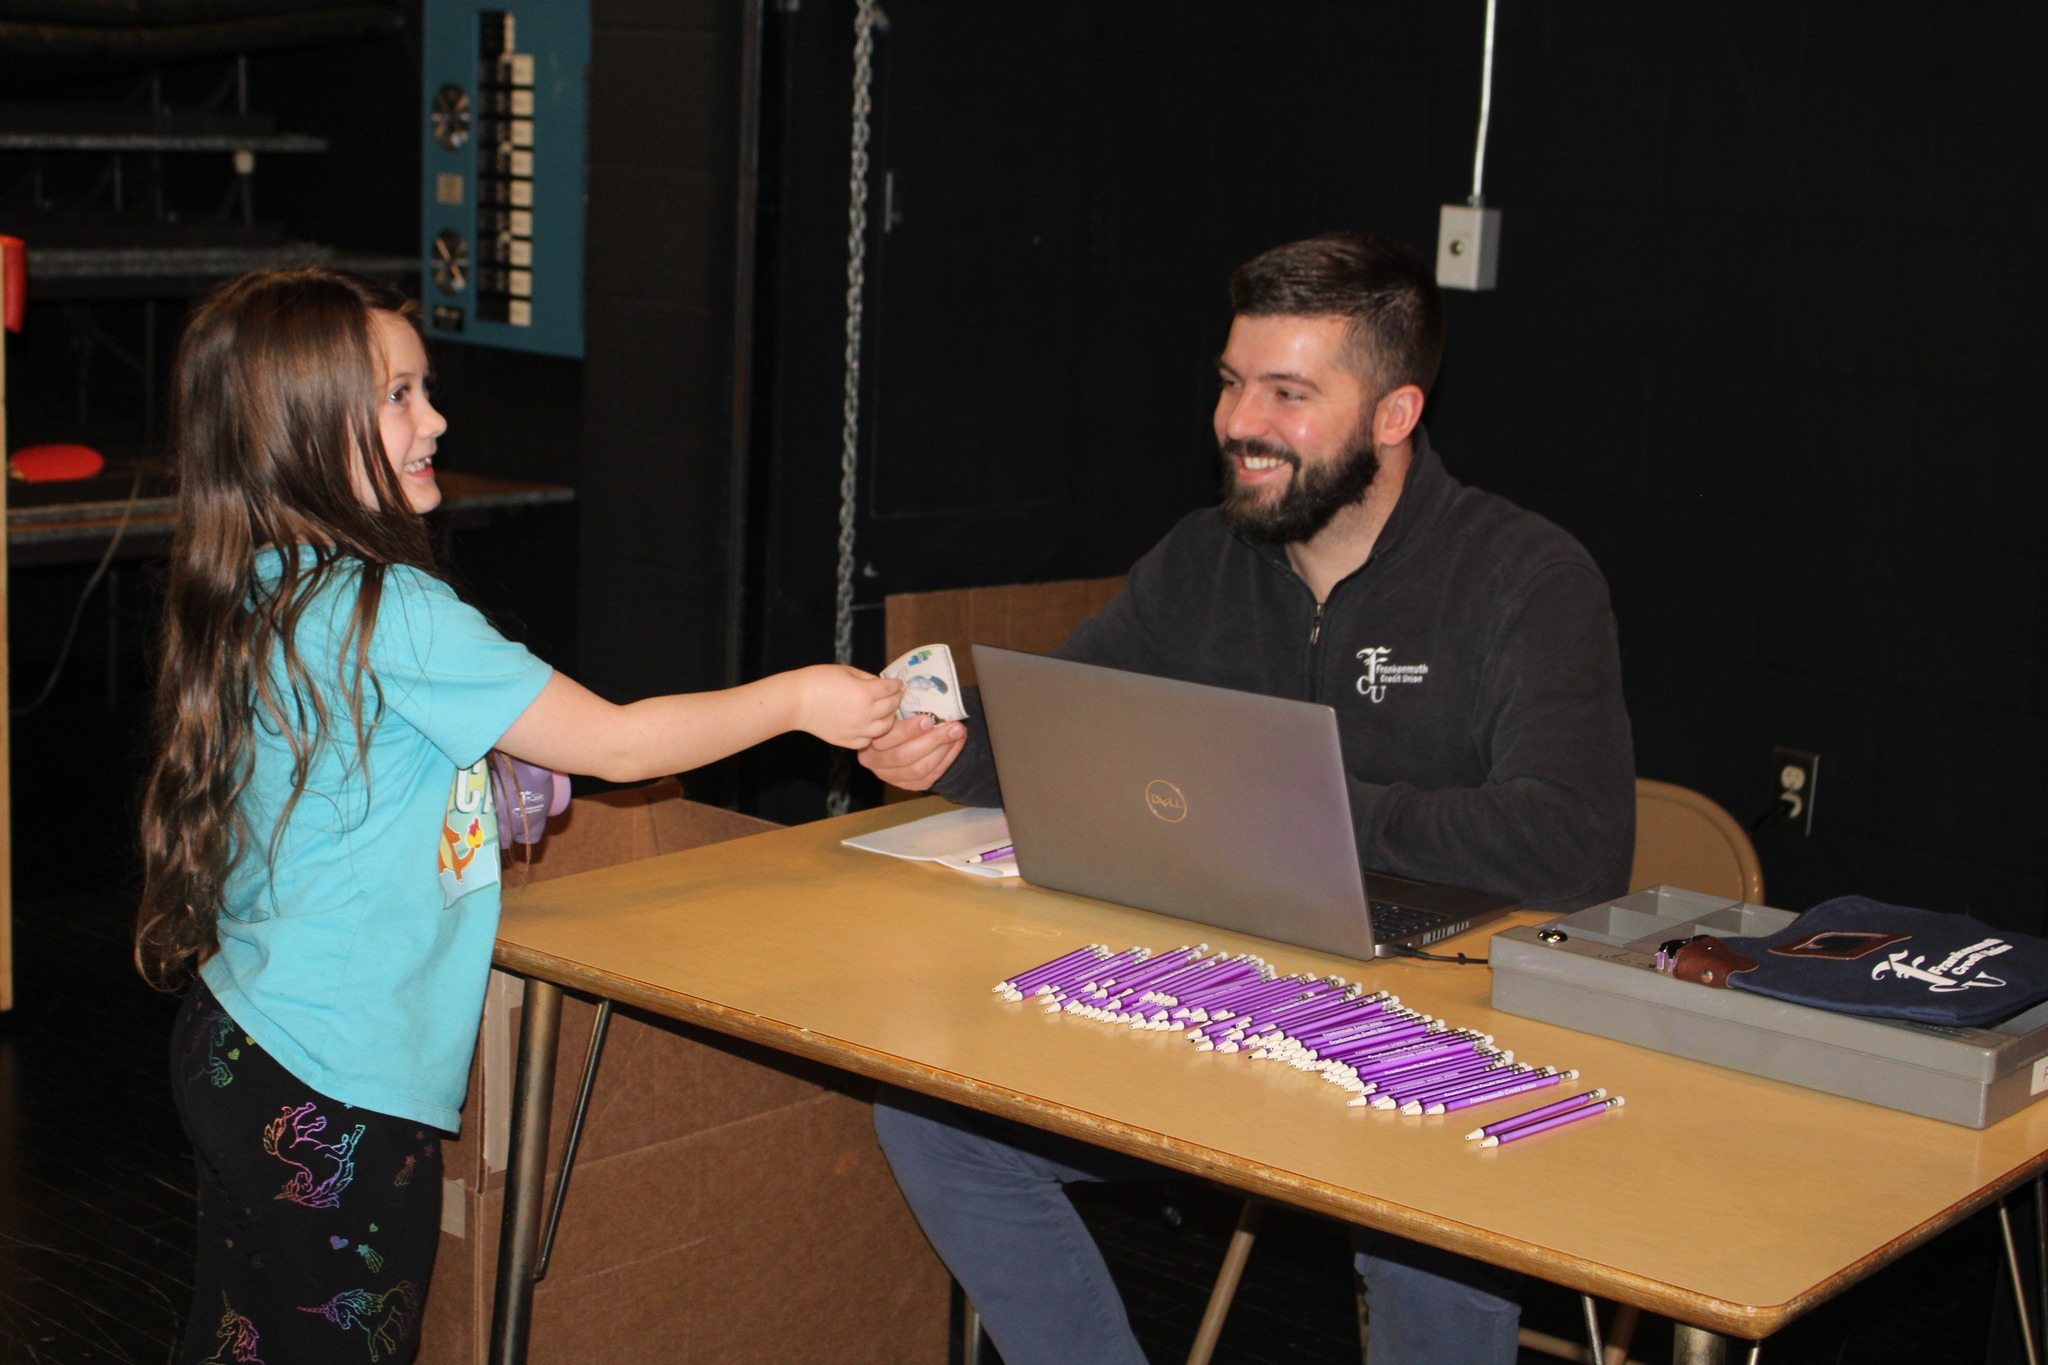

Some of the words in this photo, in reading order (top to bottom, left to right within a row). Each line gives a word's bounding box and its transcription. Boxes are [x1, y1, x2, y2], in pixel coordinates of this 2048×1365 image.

[1375, 663, 1429, 674] Frankenmuth
[1380, 674, 1402, 683] Credit
[1402, 674, 1423, 683] Union
[1469, 1089, 1504, 1104] Frankenmuth
[1504, 1085, 1521, 1097] Credit
[1521, 1082, 1537, 1092] Union
